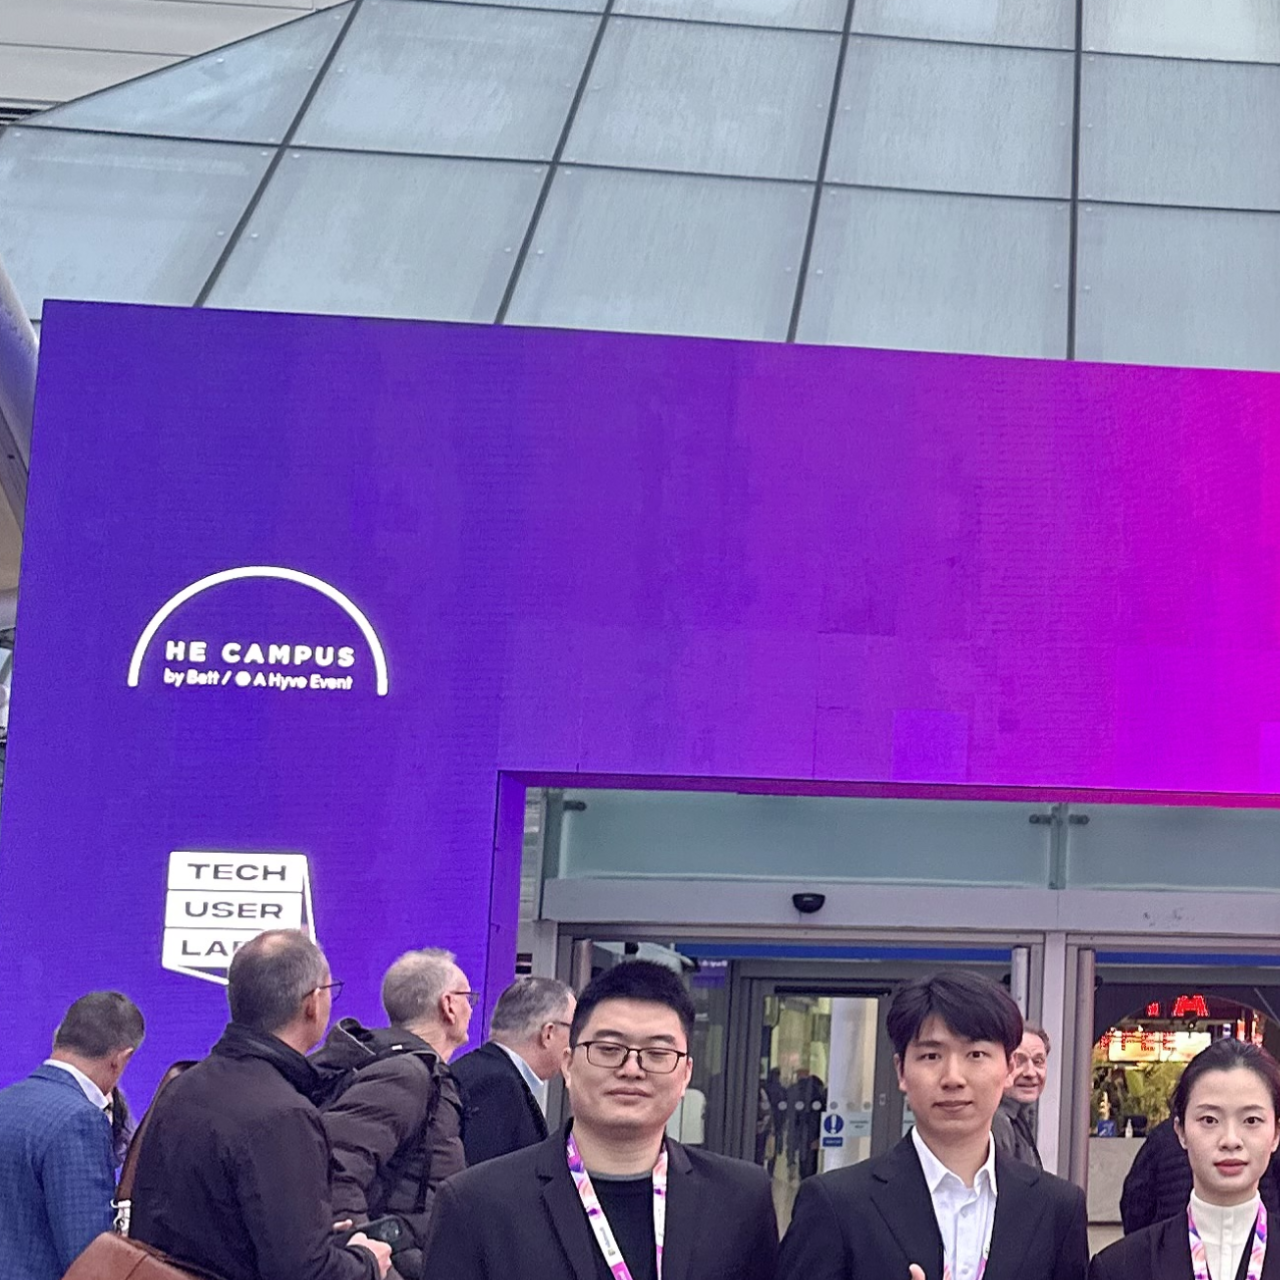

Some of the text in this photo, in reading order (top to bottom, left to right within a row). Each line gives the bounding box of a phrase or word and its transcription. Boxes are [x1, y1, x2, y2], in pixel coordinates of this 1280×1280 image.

[165, 640, 355, 667] HE CAMPUS
[163, 667, 185, 687] by
[186, 669, 220, 685] Bett
[253, 672, 267, 687] A
[268, 672, 308, 691] Hyve
[310, 674, 353, 690] Event
[187, 863, 287, 881] TECH
[184, 901, 284, 919] USER
